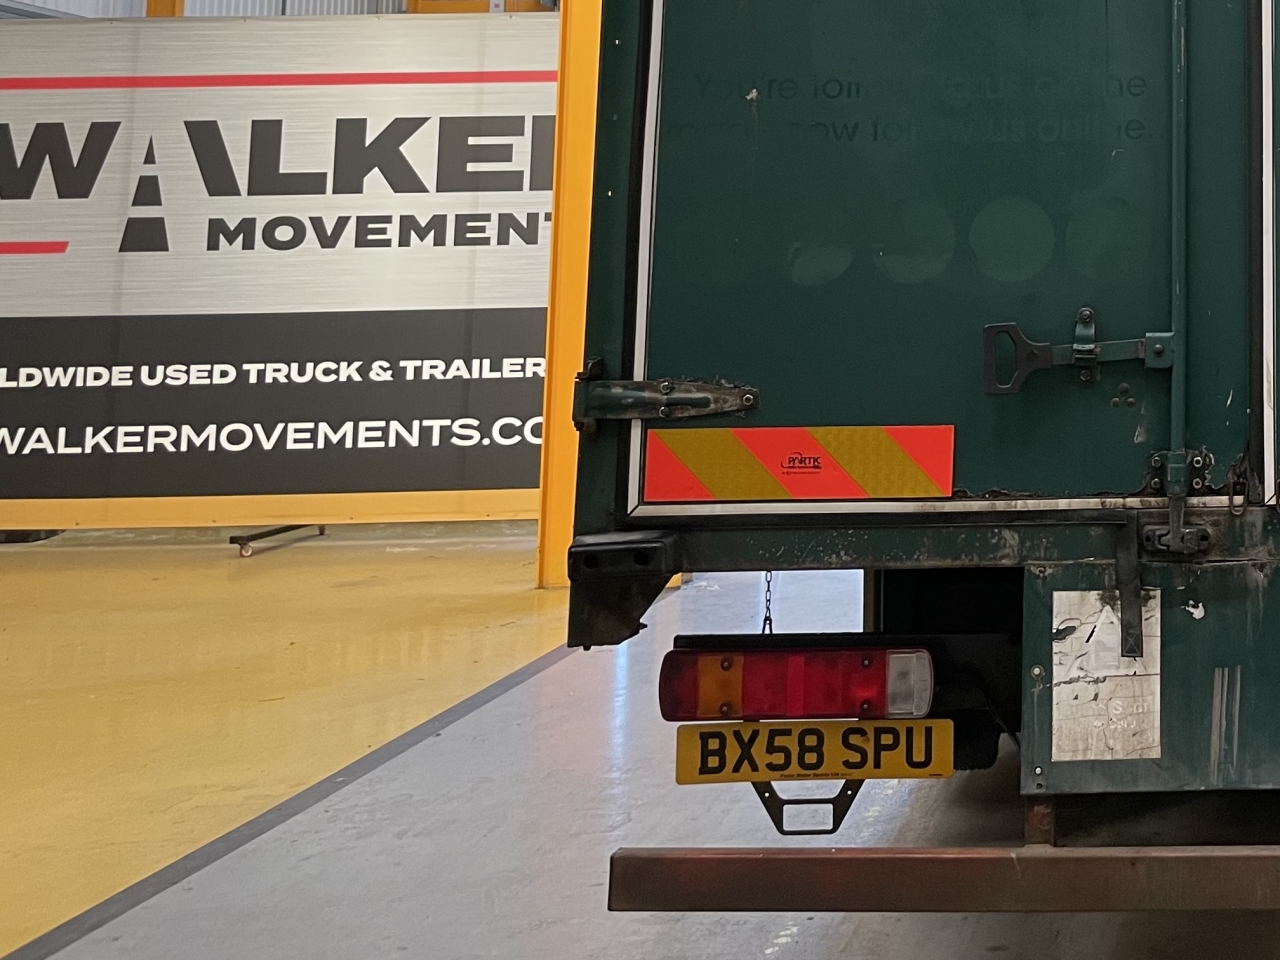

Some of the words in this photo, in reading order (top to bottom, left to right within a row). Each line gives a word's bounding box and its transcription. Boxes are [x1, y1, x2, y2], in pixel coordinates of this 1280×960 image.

[207, 212, 553, 252] MOVEMEN
[140, 364, 237, 386] USED
[242, 361, 362, 384] TRUCK
[369, 359, 394, 382] &
[698, 728, 825, 776] BX58
[841, 726, 933, 771] SPU
